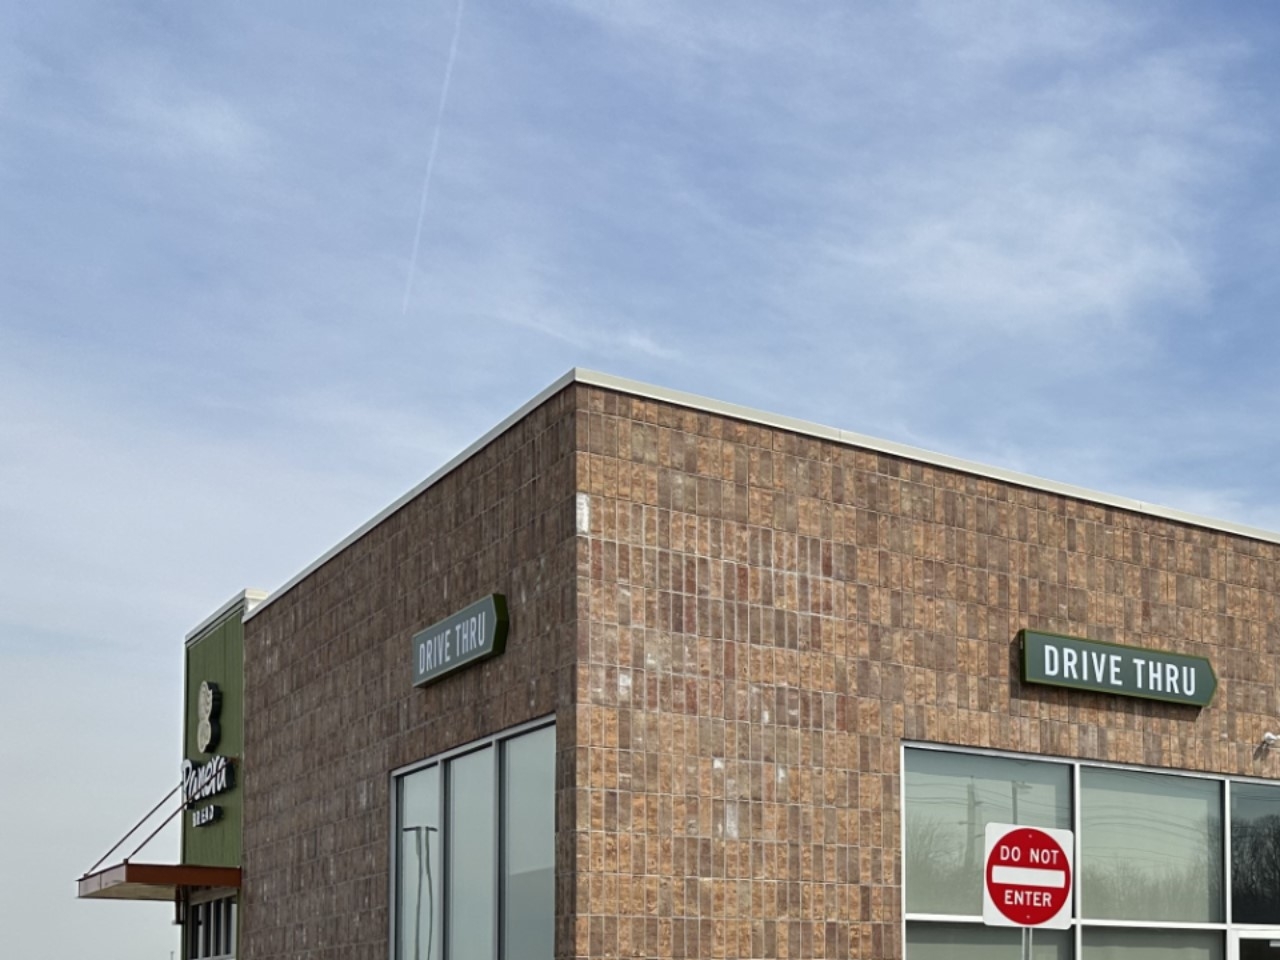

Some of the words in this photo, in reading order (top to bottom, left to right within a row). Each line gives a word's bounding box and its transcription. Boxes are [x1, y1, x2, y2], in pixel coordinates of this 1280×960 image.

[419, 629, 451, 675] DRIVE
[455, 611, 486, 657] THRU
[1044, 644, 1123, 686] DRIVE
[1132, 658, 1196, 696] THRU
[181, 755, 227, 811] Panera
[1000, 845, 1021, 862] DO
[1029, 848, 1060, 865] NOT
[1004, 889, 1052, 908] ENTER
